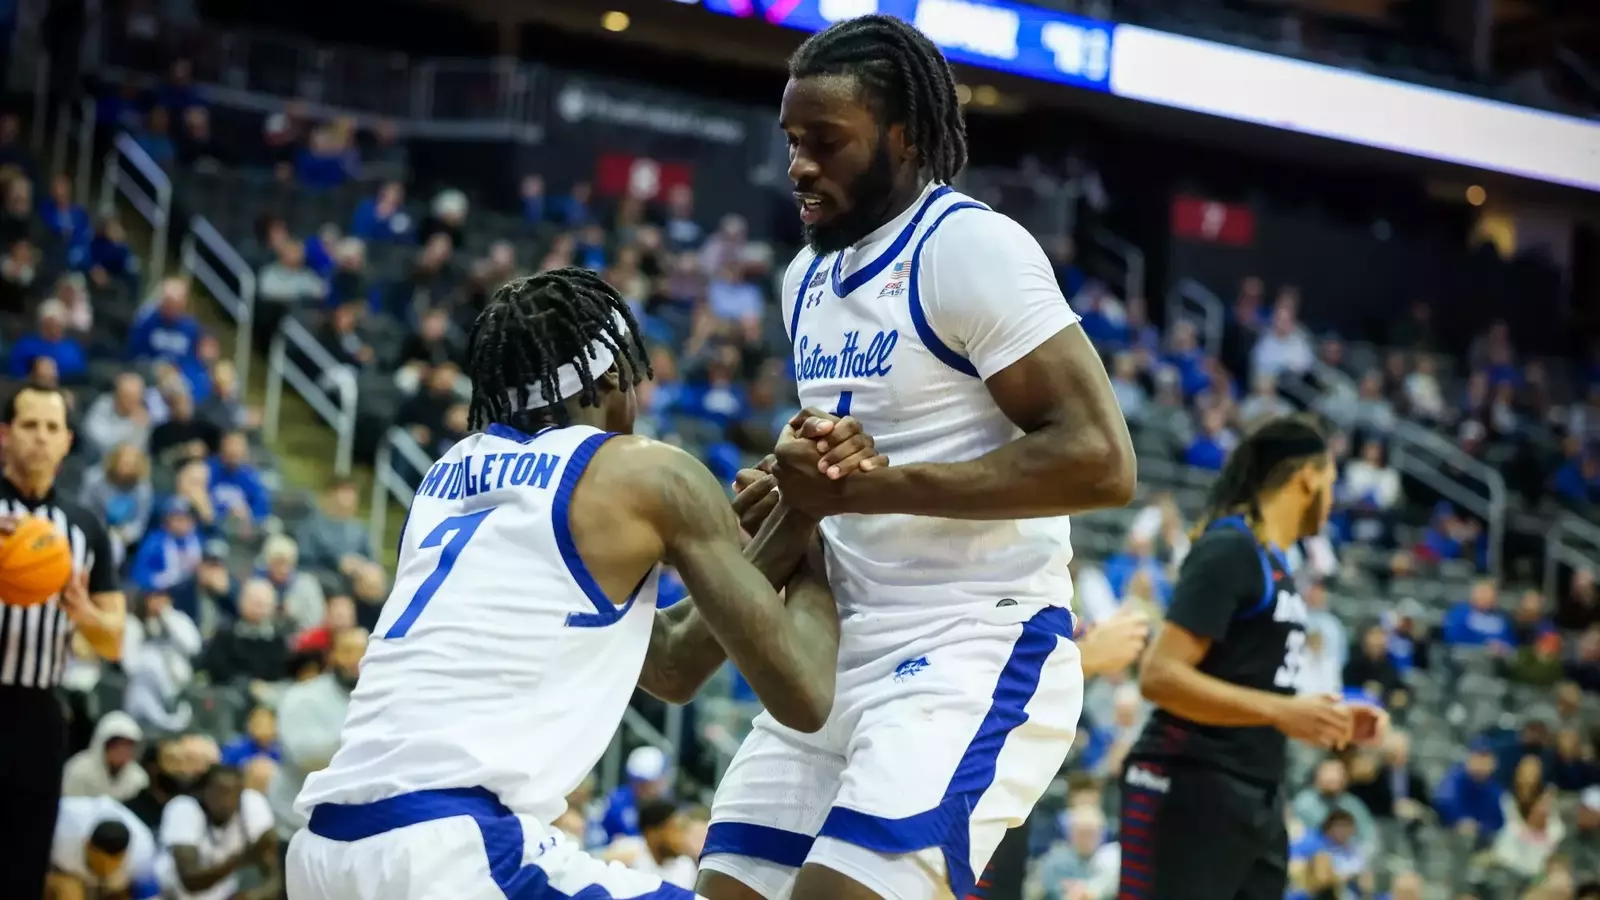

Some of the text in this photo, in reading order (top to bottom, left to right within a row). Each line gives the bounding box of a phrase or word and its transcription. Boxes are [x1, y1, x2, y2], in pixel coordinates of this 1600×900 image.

[879, 288, 906, 297] EAST
[797, 330, 899, 381] Seton Hall
[416, 452, 561, 500] MIDLETON
[384, 507, 498, 640] 7
